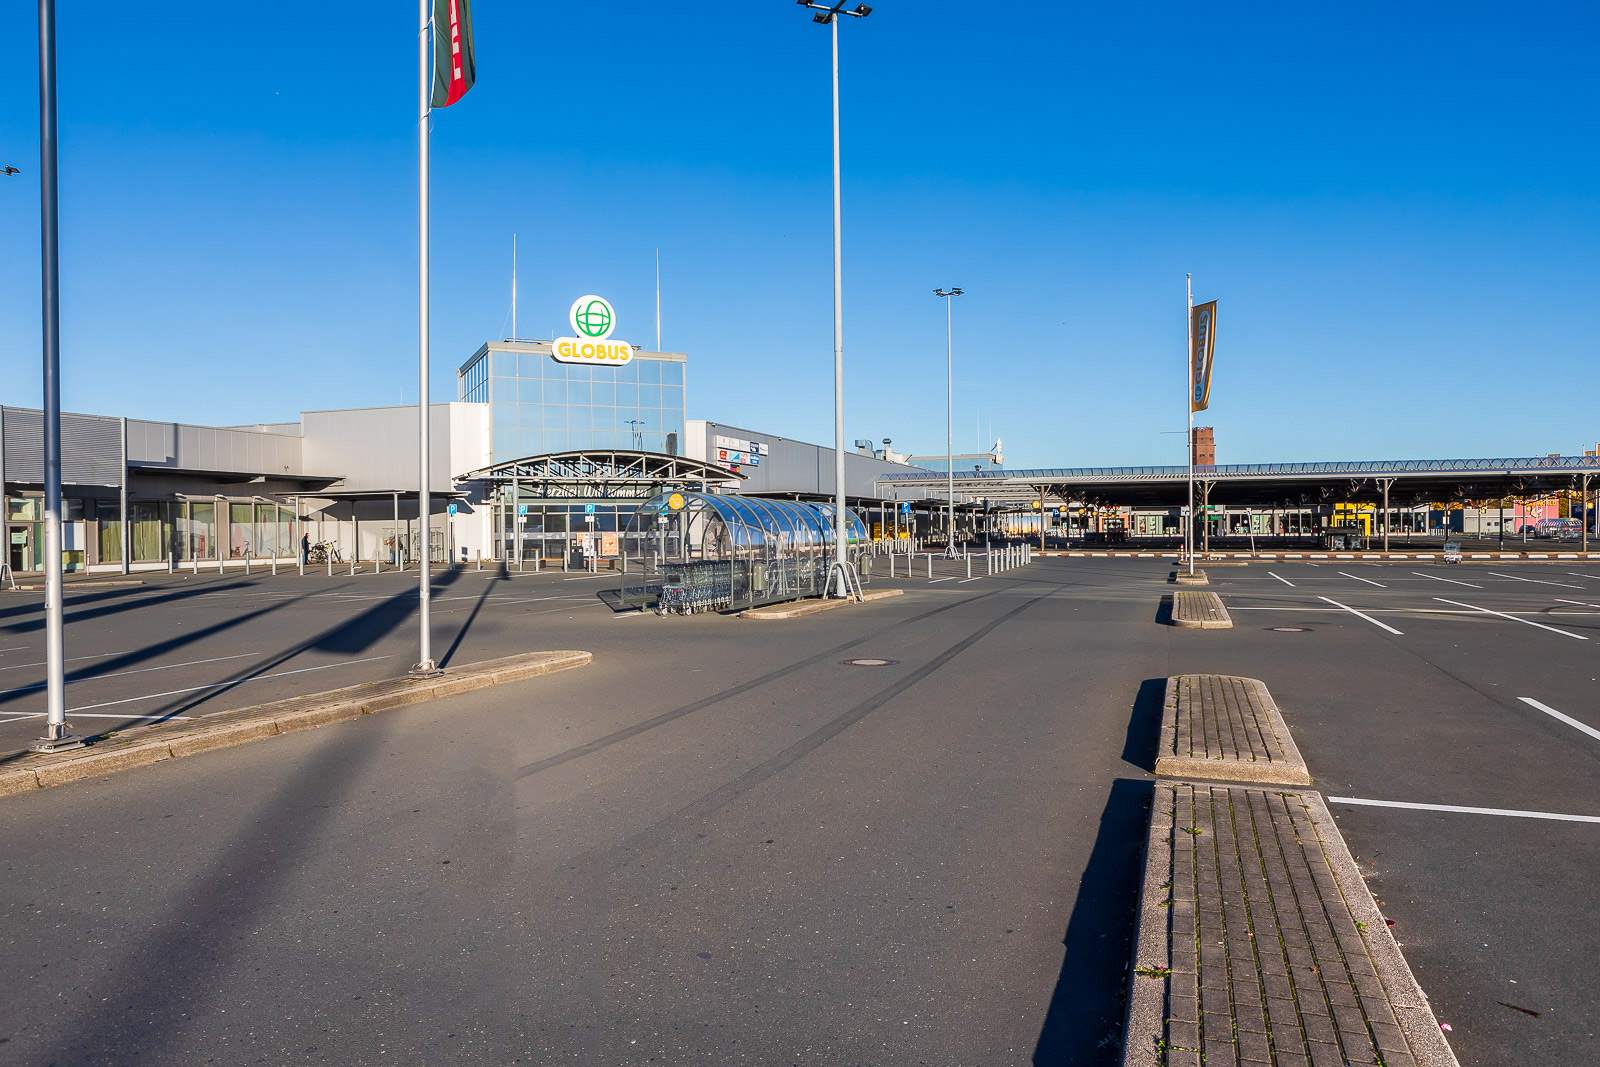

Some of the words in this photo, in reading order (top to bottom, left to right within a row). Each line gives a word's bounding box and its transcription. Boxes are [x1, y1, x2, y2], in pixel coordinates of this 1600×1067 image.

[558, 342, 629, 361] GLOBUS
[1196, 314, 1208, 385] GLOBUS
[450, 505, 456, 513] P
[520, 505, 525, 513] P
[587, 504, 592, 512] P
